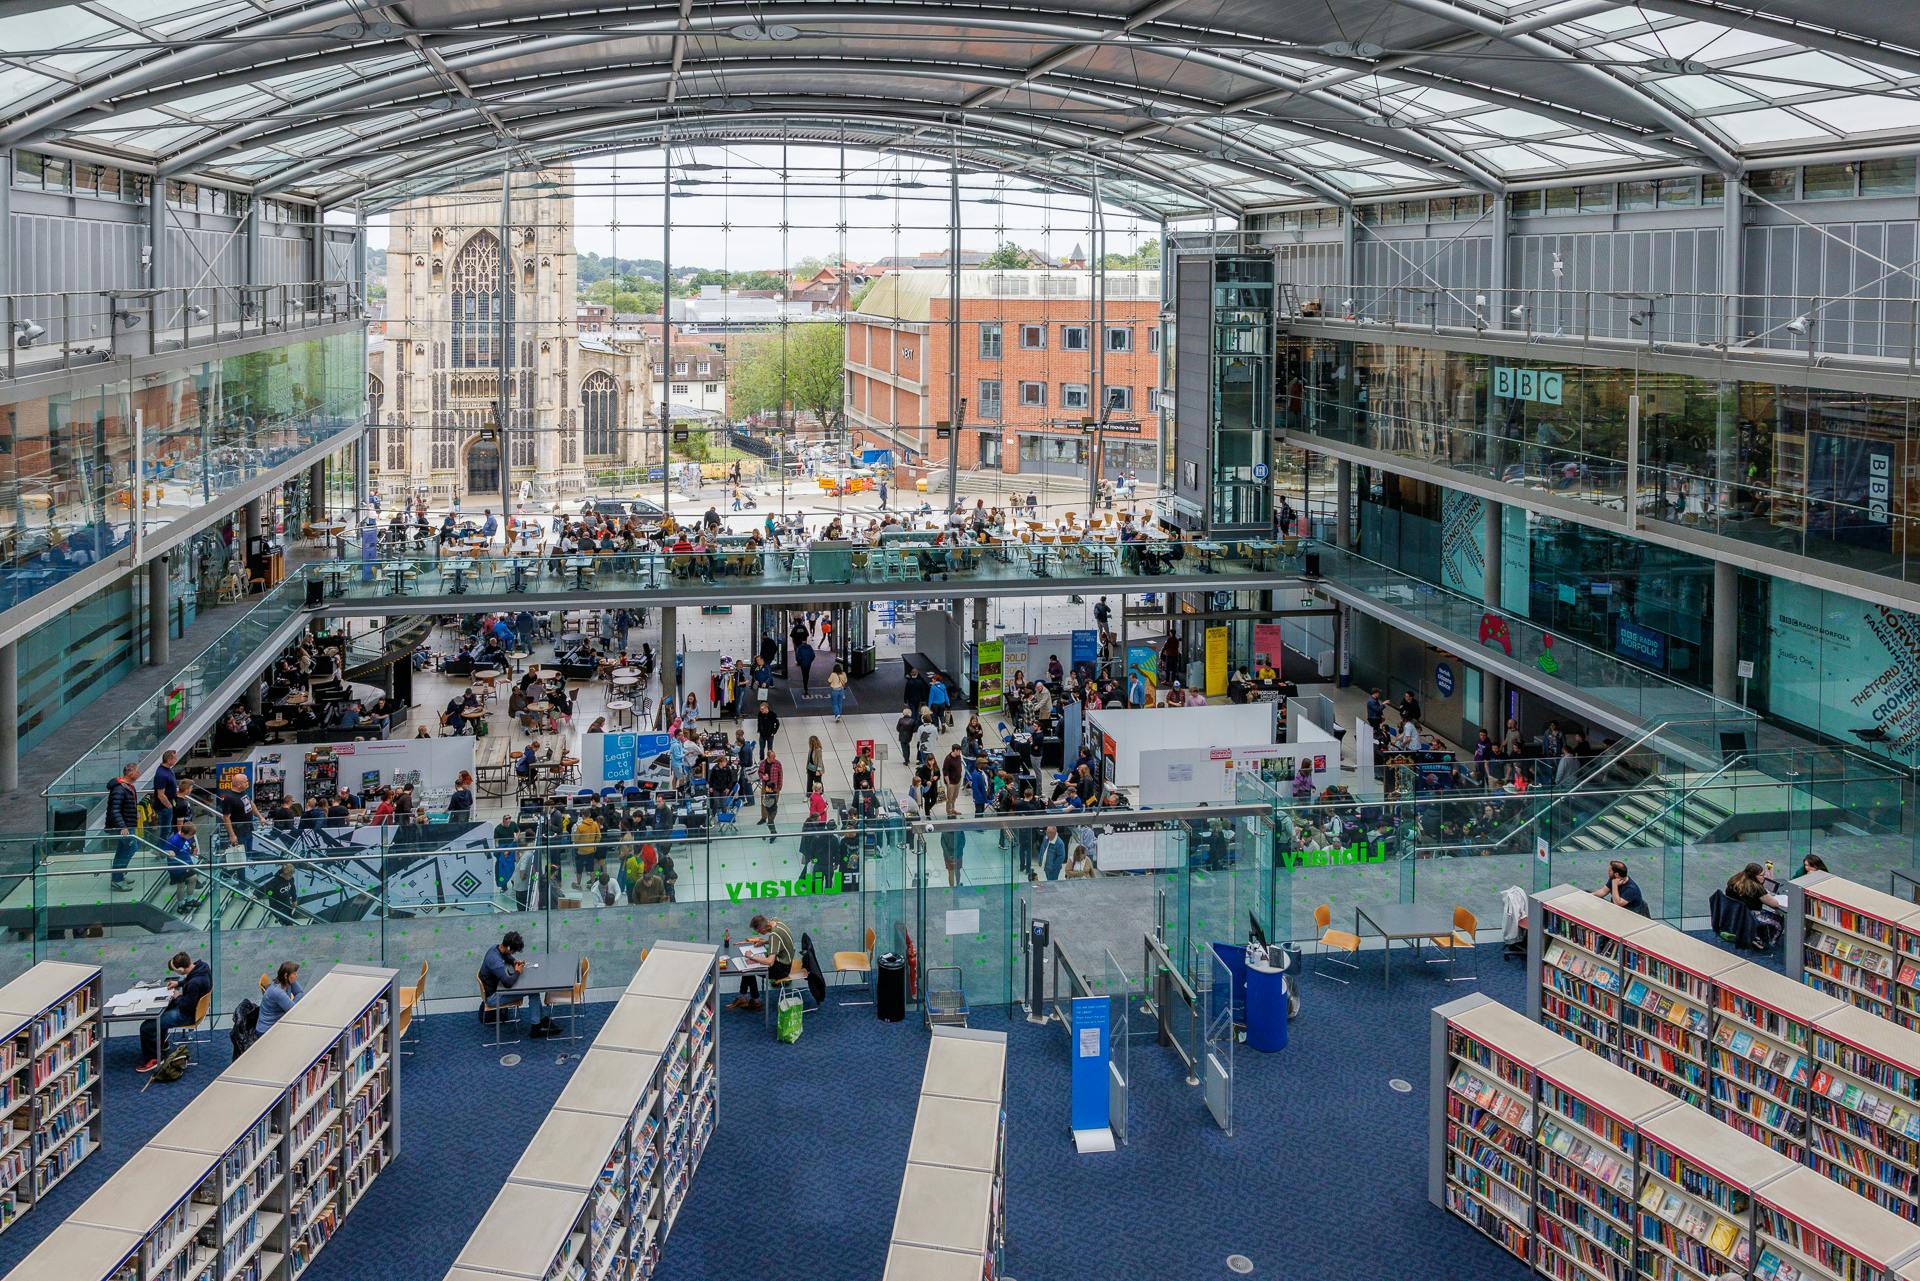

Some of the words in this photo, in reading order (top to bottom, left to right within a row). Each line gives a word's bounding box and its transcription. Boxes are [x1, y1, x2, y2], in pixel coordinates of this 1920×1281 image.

[1496, 369, 1560, 403] BBC
[1870, 456, 1888, 521] BBC
[1463, 499, 1481, 523] LYNN
[1639, 636, 1659, 648] RADIO
[1799, 621, 1819, 632] RADIO
[1819, 628, 1851, 642] NORFOLK
[1621, 637, 1657, 657] NORFOLK
[1864, 614, 1913, 678] FAKENHAM
[1851, 665, 1900, 707] THETFORD
[1881, 674, 1907, 696] WELLS
[1872, 678, 1920, 722] CROMER
[605, 751, 632, 761] Learn
[222, 766, 246, 774] LAST
